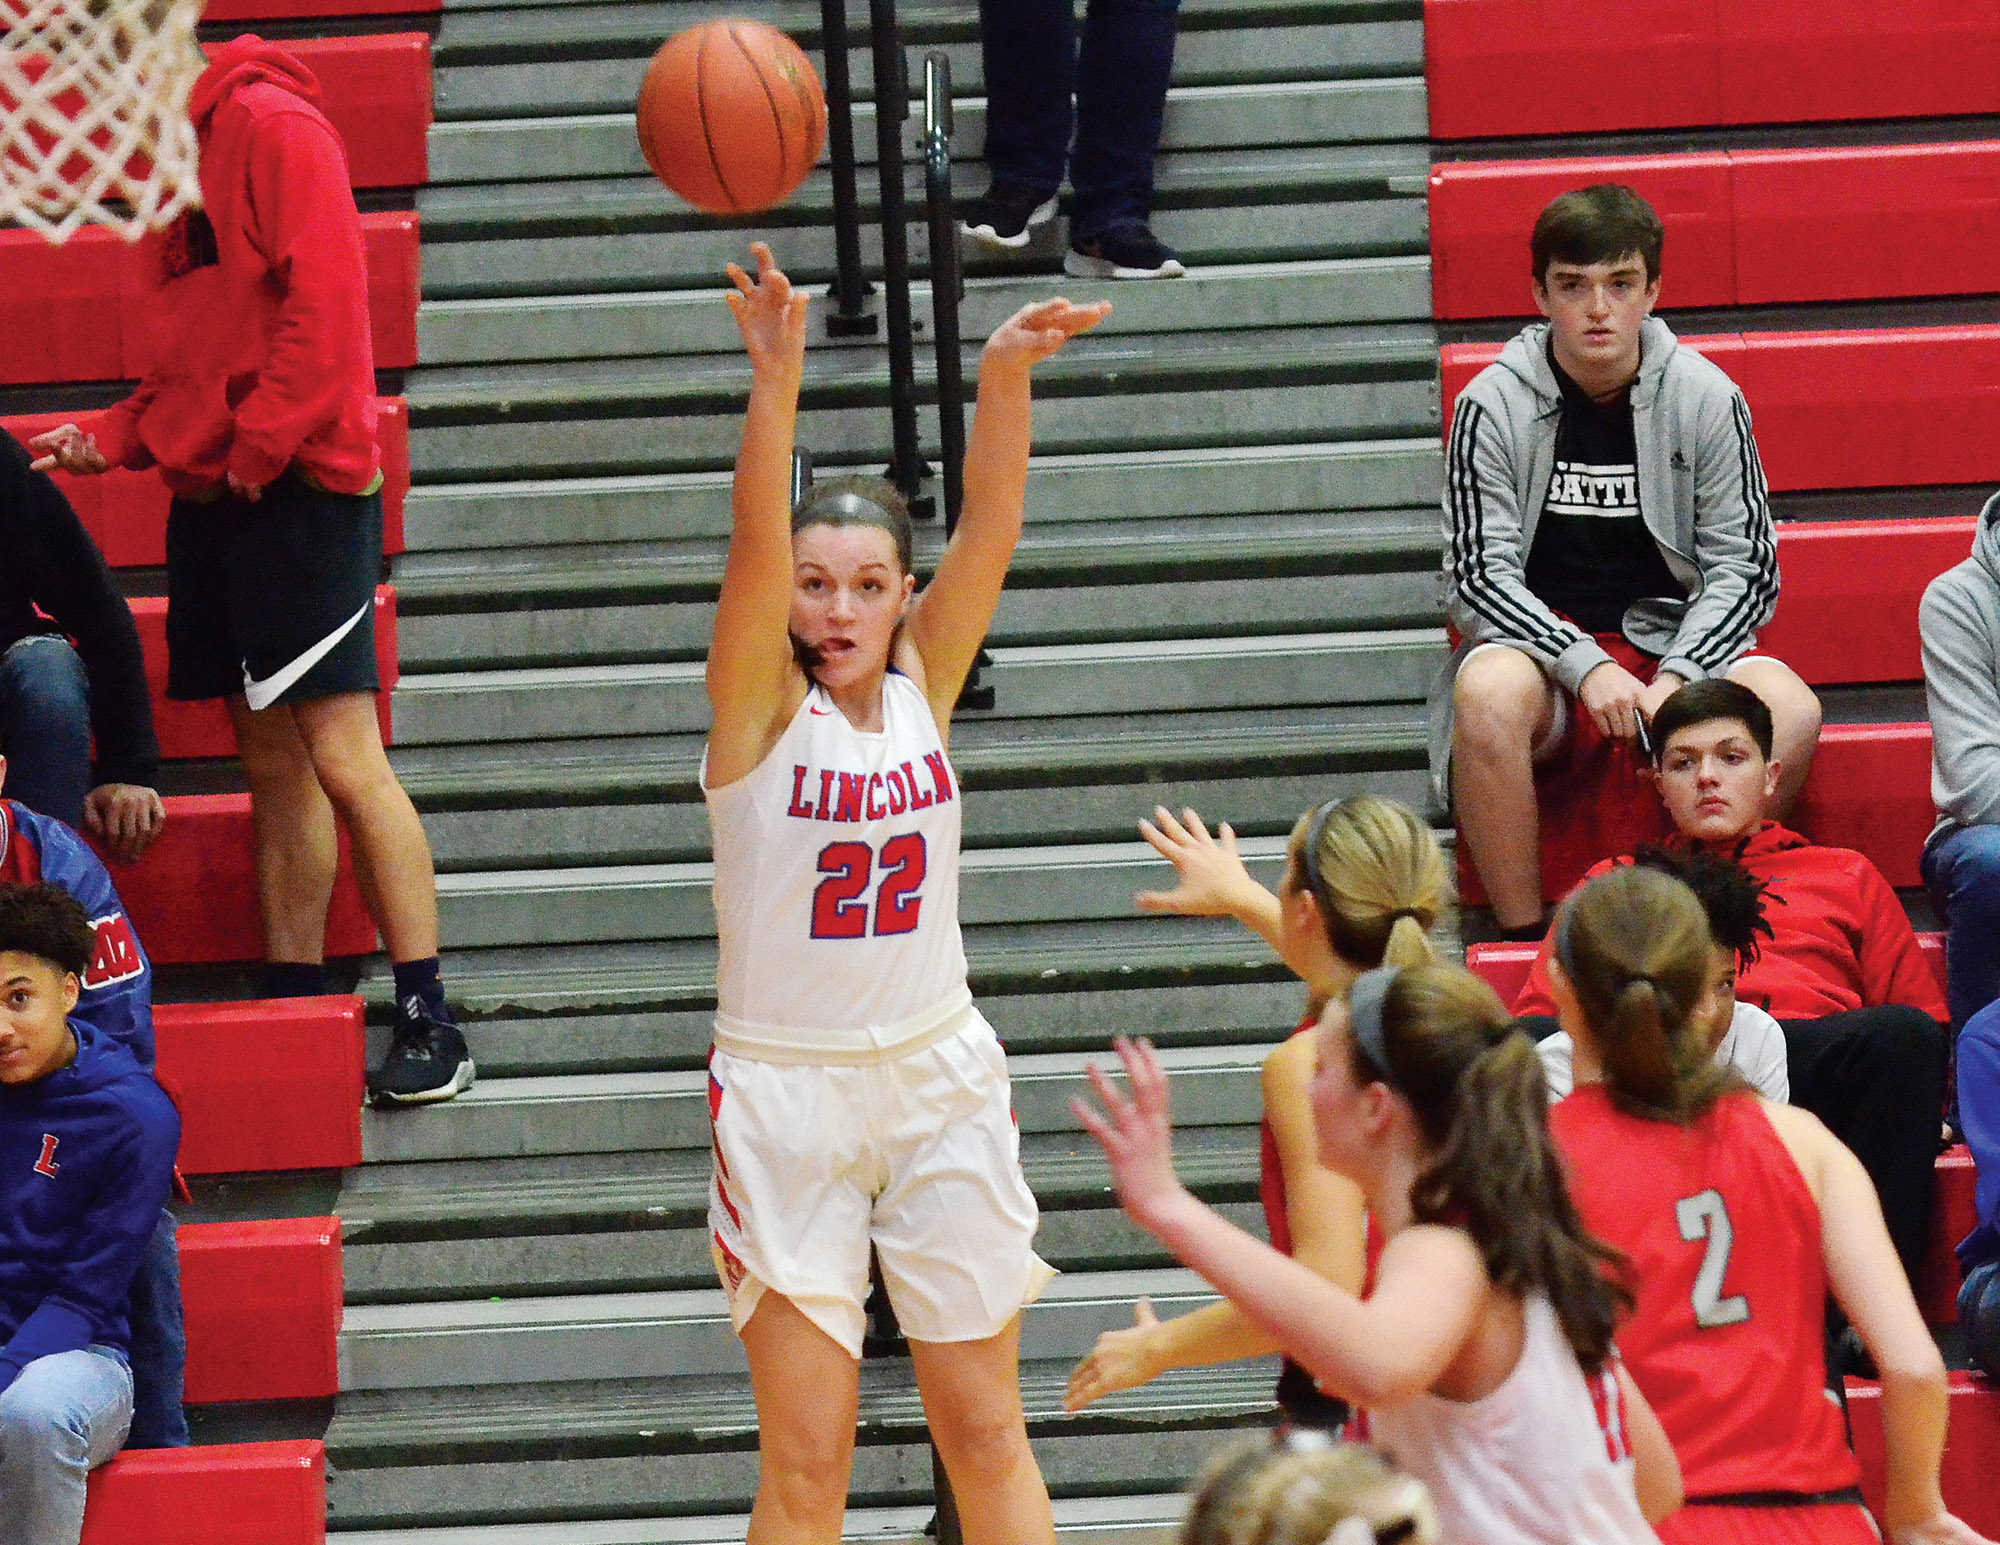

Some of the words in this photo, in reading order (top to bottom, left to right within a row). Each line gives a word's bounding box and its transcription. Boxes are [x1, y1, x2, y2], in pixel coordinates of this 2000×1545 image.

[787, 750, 953, 822] LINCOLN
[810, 831, 927, 939] 22
[34, 1133, 60, 1178] L
[1676, 1189, 1750, 1328] 2
